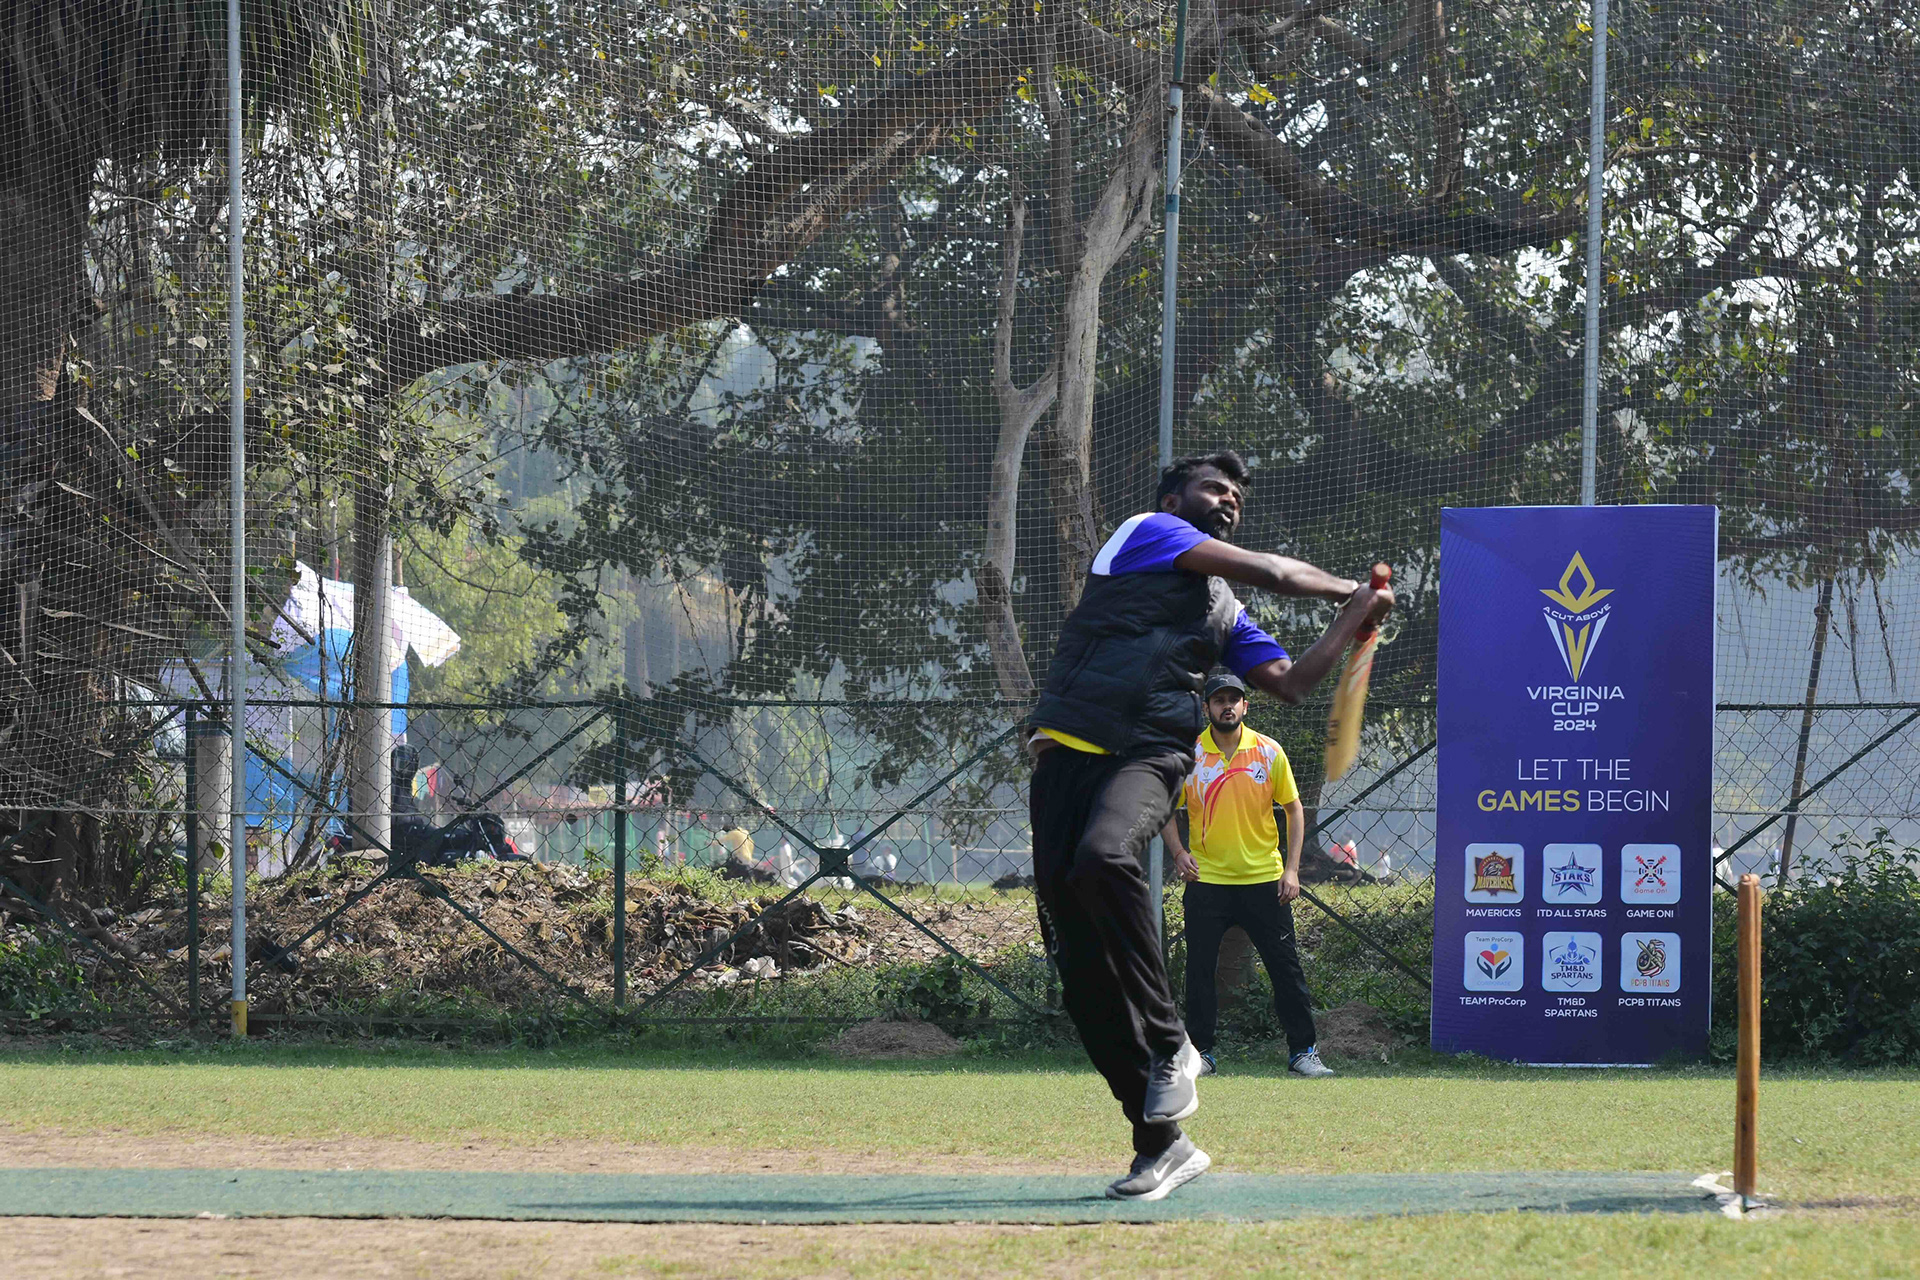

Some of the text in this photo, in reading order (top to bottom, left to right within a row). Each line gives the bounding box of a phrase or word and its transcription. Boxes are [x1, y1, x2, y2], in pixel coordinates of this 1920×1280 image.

[1551, 610, 1574, 621] CUT
[1575, 603, 1612, 622] ABOVE
[1526, 686, 1625, 700] VIRGINIA
[1551, 702, 1600, 716] CUP
[1553, 719, 1597, 731] 2024
[1517, 759, 1631, 781] LET THE
[1477, 790, 1669, 812] GAMES BEGIN
[1554, 872, 1591, 883] STARS
[1475, 876, 1513, 890] MAVERICKS
[1466, 909, 1522, 917] MAVERICKS
[1537, 909, 1607, 918] ITD ALL STARS
[1626, 910, 1674, 918] GAME ON!
[1551, 972, 1594, 980] SPARTANS
[1459, 997, 1527, 1007] TEAM ProCorp
[1557, 998, 1586, 1006] TM&D
[1618, 998, 1682, 1007] PCPB TITANS
[1544, 1009, 1598, 1018] SPARTANS
